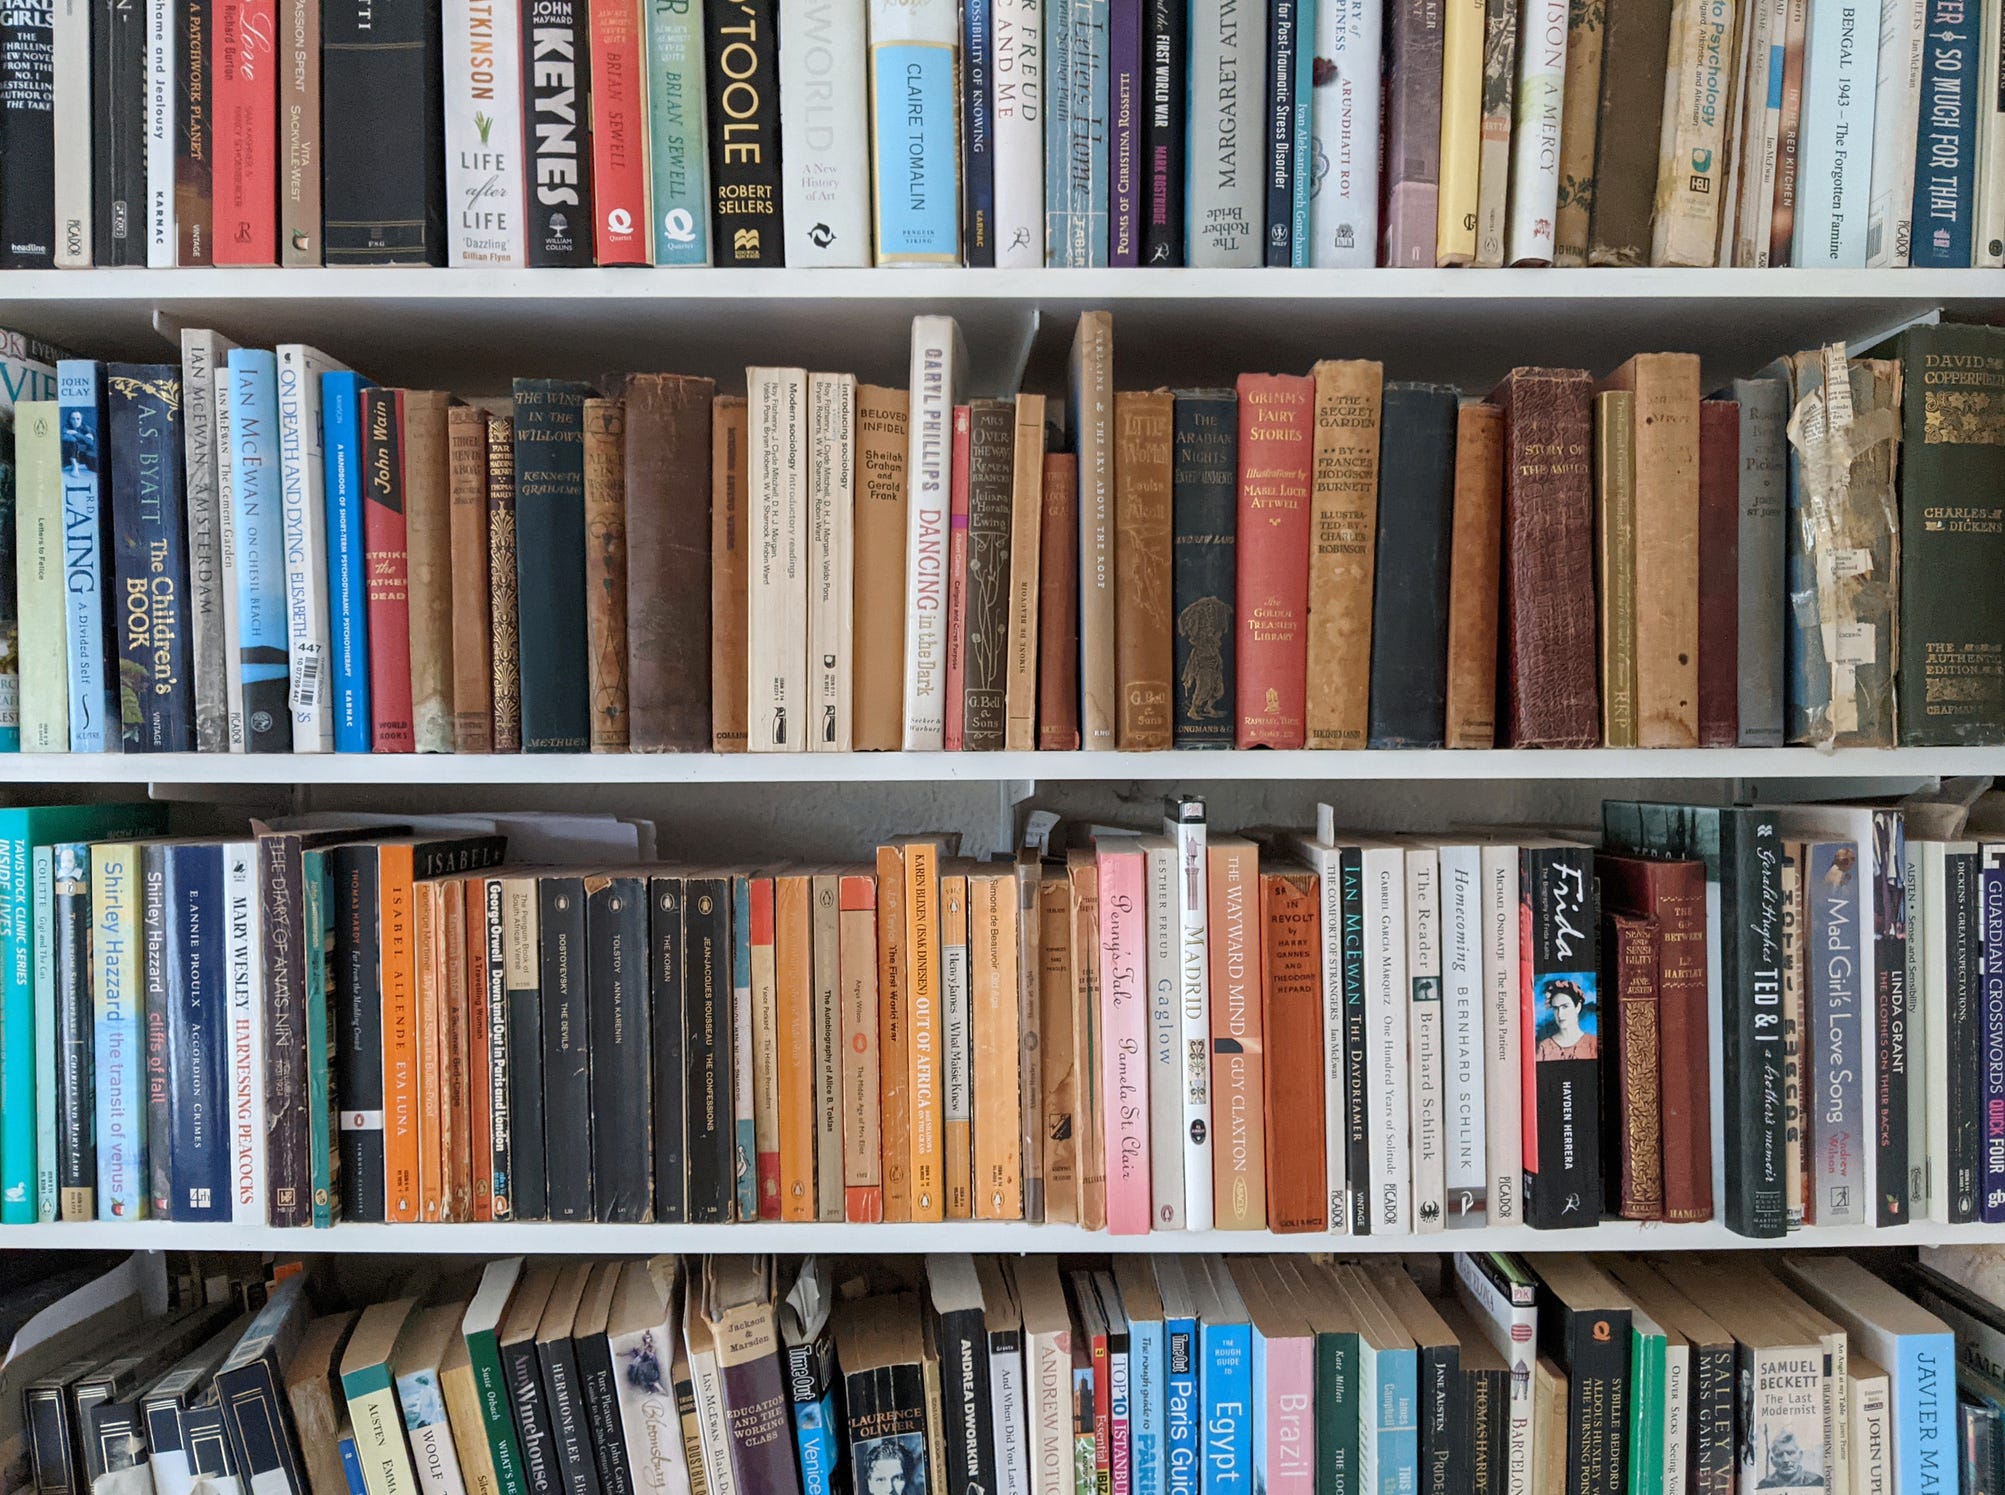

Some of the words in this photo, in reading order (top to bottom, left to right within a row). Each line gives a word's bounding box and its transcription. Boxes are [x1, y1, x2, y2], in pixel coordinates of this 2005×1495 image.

[532, 1, 572, 16] JOHN
[533, 15, 573, 24] MAYNARD
[155, 40, 164, 73] and
[1156, 34, 1170, 63] FIRST
[1840, 7, 1855, 66] BENGAL
[190, 19, 202, 102] PATCHWORK
[1019, 27, 1037, 121] FREUD
[1701, 22, 1725, 127] Psychology
[1934, 49, 1962, 71] SO
[667, 72, 681, 124] BRIAN
[907, 64, 924, 126] CLAIRE
[1118, 73, 1130, 128] ROSSETTI
[1156, 67, 1169, 101] WORLD
[1838, 79, 1850, 107] 1943
[1931, 76, 1962, 129] MUCH
[155, 79, 166, 140] Jealousy
[533, 28, 578, 206] KEYNES
[1155, 104, 1169, 127] WAR
[1219, 56, 1237, 189] MARGARET
[1277, 105, 1289, 141] Stress
[1341, 78, 1351, 166] ARUNDHATI
[191, 106, 202, 161] PLANET
[301, 141, 310, 166] VITA
[1539, 104, 1557, 175] MERCY
[1836, 122, 1848, 146] The
[1929, 133, 1958, 168] FOR
[461, 153, 505, 171] LIFE
[668, 136, 685, 199] SEWELL
[909, 133, 925, 210] TOMALIN
[1118, 131, 1130, 193] CHRISTINA
[1275, 144, 1286, 189] Disorder
[1832, 150, 1846, 210] Forgotten
[719, 186, 772, 198] ROBERT
[1120, 197, 1129, 212] OF
[1341, 172, 1350, 199] ROY
[1928, 176, 1957, 222] THAT
[155, 191, 163, 245] KARNAC
[463, 213, 507, 231] LIFE
[719, 200, 773, 214] SELLERS
[1207, 208, 1242, 220] Bride
[11, 243, 46, 253] headline
[1117, 215, 1129, 255] POEMS
[1202, 223, 1249, 235] Robber
[1212, 238, 1239, 250] The
[1830, 214, 1843, 260] Famine
[62, 378, 89, 387] JOHN
[281, 370, 296, 397] ON
[1925, 355, 1985, 370] DAVID
[61, 388, 90, 397] CLAY
[239, 369, 257, 406] IAN
[282, 402, 299, 461] DEATH
[375, 402, 387, 441] Wain
[861, 409, 907, 422] BELOVED
[863, 421, 905, 434] INFIDEL
[1258, 411, 1294, 423] FAIRY
[1319, 418, 1375, 429] GARDEN
[1320, 407, 1374, 418] SECRET
[789, 421, 797, 470] sociology
[922, 406, 941, 492] PHILLIPS
[1249, 427, 1303, 442] STORIES
[373, 447, 392, 494] John
[866, 451, 903, 462] Sheilah
[866, 462, 902, 471] Graham
[140, 453, 160, 525] BYATT
[285, 465, 301, 505] AND
[1924, 508, 1987, 520] CHARLES
[1949, 521, 2003, 533] DICKENS
[65, 484, 94, 595] LAING
[150, 538, 168, 572] The
[286, 507, 304, 564] DYING
[376, 562, 396, 575] the
[917, 509, 940, 611] DANCING
[127, 577, 150, 650] BOOK
[291, 572, 307, 638] ELISABETH
[371, 593, 406, 601] DEAD
[78, 614, 90, 658] Divided
[152, 576, 178, 695] Children's
[299, 643, 321, 653] 447
[80, 660, 90, 684] Self
[14, 839, 24, 902] TAVISTOCK
[1229, 857, 1238, 882] THE
[1345, 867, 1360, 900] IAN
[1418, 869, 1429, 900] The
[1757, 847, 1778, 903] Gerald
[105, 862, 122, 931] Shirley
[233, 896, 246, 938] MARY
[1552, 861, 1585, 962] Frida
[17, 905, 25, 946] CLINIC
[392, 887, 402, 959] ISABEL
[1227, 886, 1244, 980] WAYWARD
[1271, 914, 1313, 924] REVOLT
[1418, 909, 1429, 969] Reader
[1453, 868, 1469, 972] Homecoming
[1751, 902, 1778, 963] Hughes
[1827, 898, 1851, 950] Mad
[18, 949, 27, 985] SERIES
[105, 937, 124, 1022] Hazzard
[233, 941, 249, 1010] WESLEY
[558, 934, 567, 995] DOSTOYEVSKY
[1185, 926, 1204, 1021] MADRID
[1828, 952, 1852, 1007] Girl's
[1755, 969, 1777, 1005] TED
[394, 971, 405, 1049] ALLENDE
[560, 1003, 568, 1019] THE
[916, 997, 930, 1030] OUT
[1155, 979, 1171, 1066] Gaglow
[1229, 985, 1245, 1036] MIND
[1350, 1014, 1361, 1042] THE
[108, 1032, 124, 1060] the
[560, 1022, 569, 1049] DEVILS
[917, 1033, 931, 1052] OF
[1420, 1013, 1433, 1091] Bernhard
[1457, 987, 1469, 1083] BERNHARD
[111, 1062, 124, 1115] transit
[236, 1019, 251, 1120] HARNESSING
[396, 1062, 407, 1088] EVA
[917, 1055, 931, 1108] AFRICA
[1119, 1038, 1138, 1099] Pamela
[1231, 1057, 1245, 1090] GUY
[396, 1096, 407, 1136] LUNA
[1350, 1050, 1362, 1142] DAYDREAMER
[1562, 1081, 1572, 1122] HAYDEN
[1826, 1071, 1852, 1123] Song
[111, 1117, 126, 1138] of
[1231, 1095, 1246, 1171] CLAXTON
[1422, 1099, 1433, 1160] Schlink
[1460, 1092, 1471, 1169] SCHLINK
[1563, 1127, 1573, 1170] HERRERA
[112, 1140, 123, 1193] venus
[236, 1122, 253, 1205] PEACOCKS
[1121, 1136, 1141, 1181] Clair
[1989, 1138, 2004, 1173] FOUR
[728, 1316, 766, 1333] Jackson
[730, 1335, 769, 1353] Marsden
[961, 1339, 974, 1394] ANDREA
[1113, 1358, 1127, 1394] TOP
[1436, 1363, 1446, 1388] JANE
[1760, 1376, 1818, 1390] BECKETT
[1761, 1361, 1817, 1374] SAMUEL
[553, 1363, 573, 1441] HERMIONE
[567, 1443, 579, 1464] LEE
[851, 1408, 922, 1426] LAURENCE
[1113, 1396, 1128, 1415] 10
[1170, 1382, 1192, 1439] Paris
[1436, 1390, 1446, 1432] AUSTEN
[1762, 1406, 1816, 1416] Modernist
[1764, 1395, 1783, 1405] The
[1788, 1394, 1812, 1404] Last
[1917, 1352, 1938, 1443] JAVIER
[368, 1403, 385, 1447] AUSTEN
[734, 1418, 785, 1439] WORKING
[745, 1431, 778, 1447] CLASS
[860, 1421, 914, 1438] OLIVIER
[961, 1398, 978, 1477] DWORKIN
[1209, 1401, 1242, 1482] Egypt
[1279, 1394, 1308, 1478] Brazil
[422, 1430, 444, 1480] WOOLF
